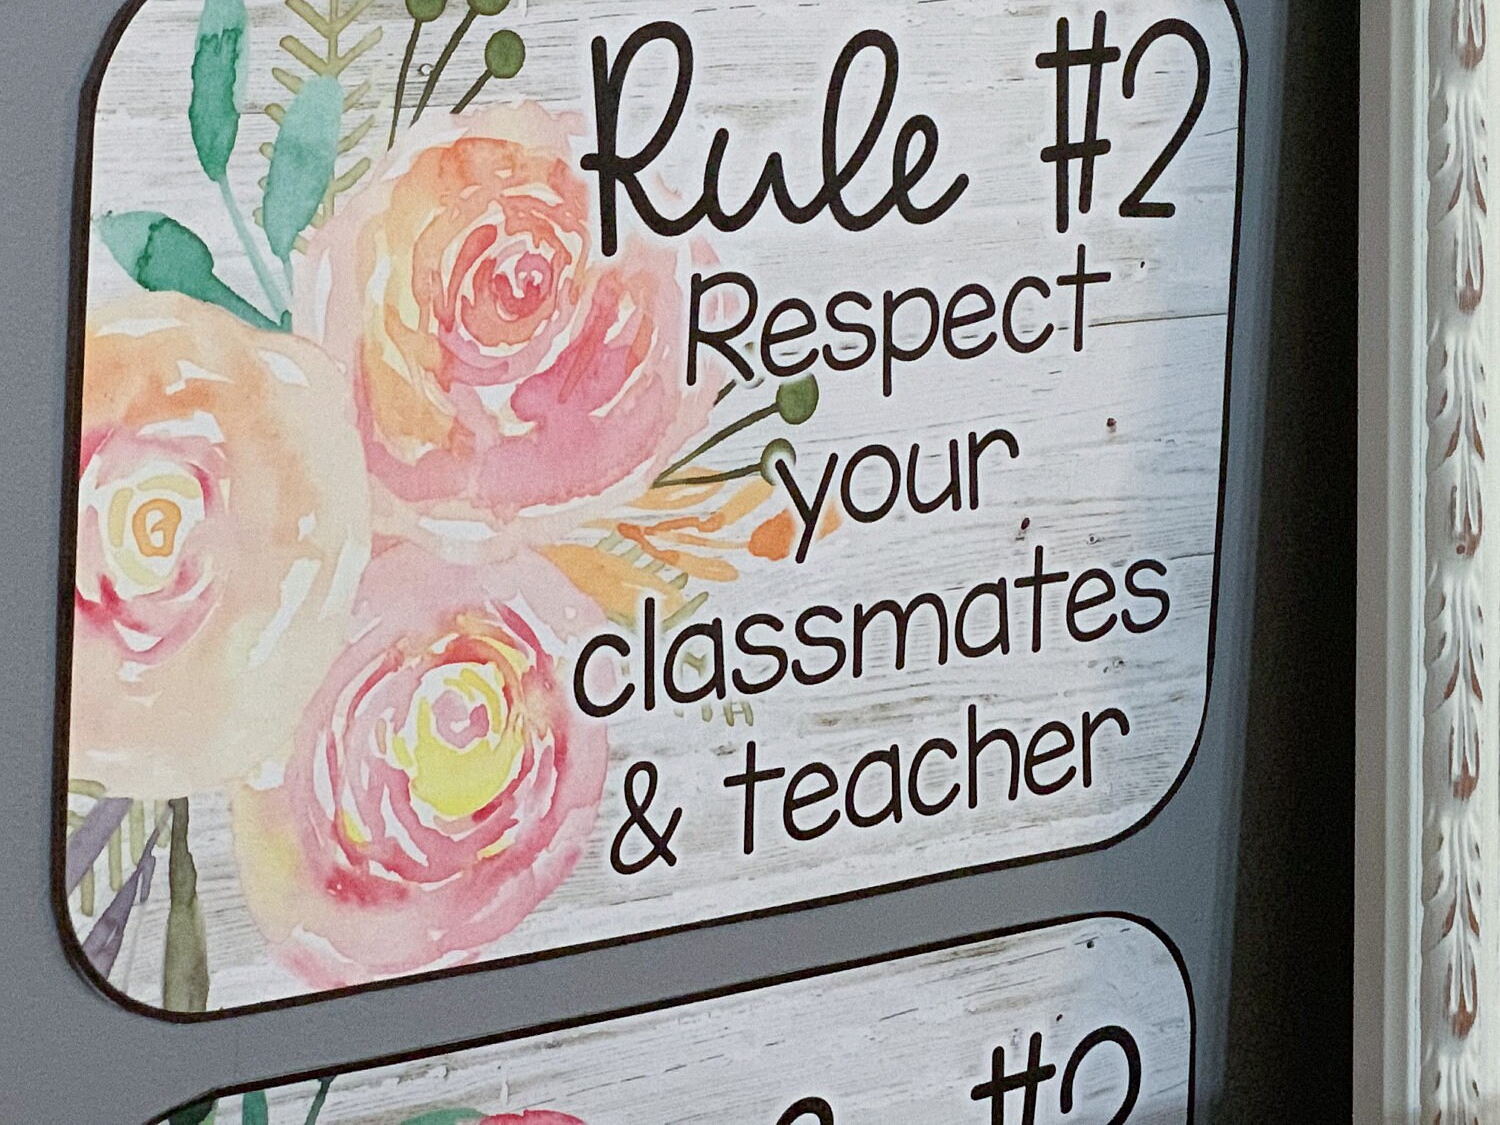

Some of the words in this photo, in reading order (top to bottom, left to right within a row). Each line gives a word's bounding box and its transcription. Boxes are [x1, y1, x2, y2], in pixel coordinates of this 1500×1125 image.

[580, 20, 969, 257] Rule
[1035, 10, 1211, 234] #2
[686, 244, 1112, 398] Respect
[774, 428, 1020, 564] your
[573, 545, 1171, 718] classmates
[610, 761, 683, 875] &
[723, 704, 1130, 855] teacher
